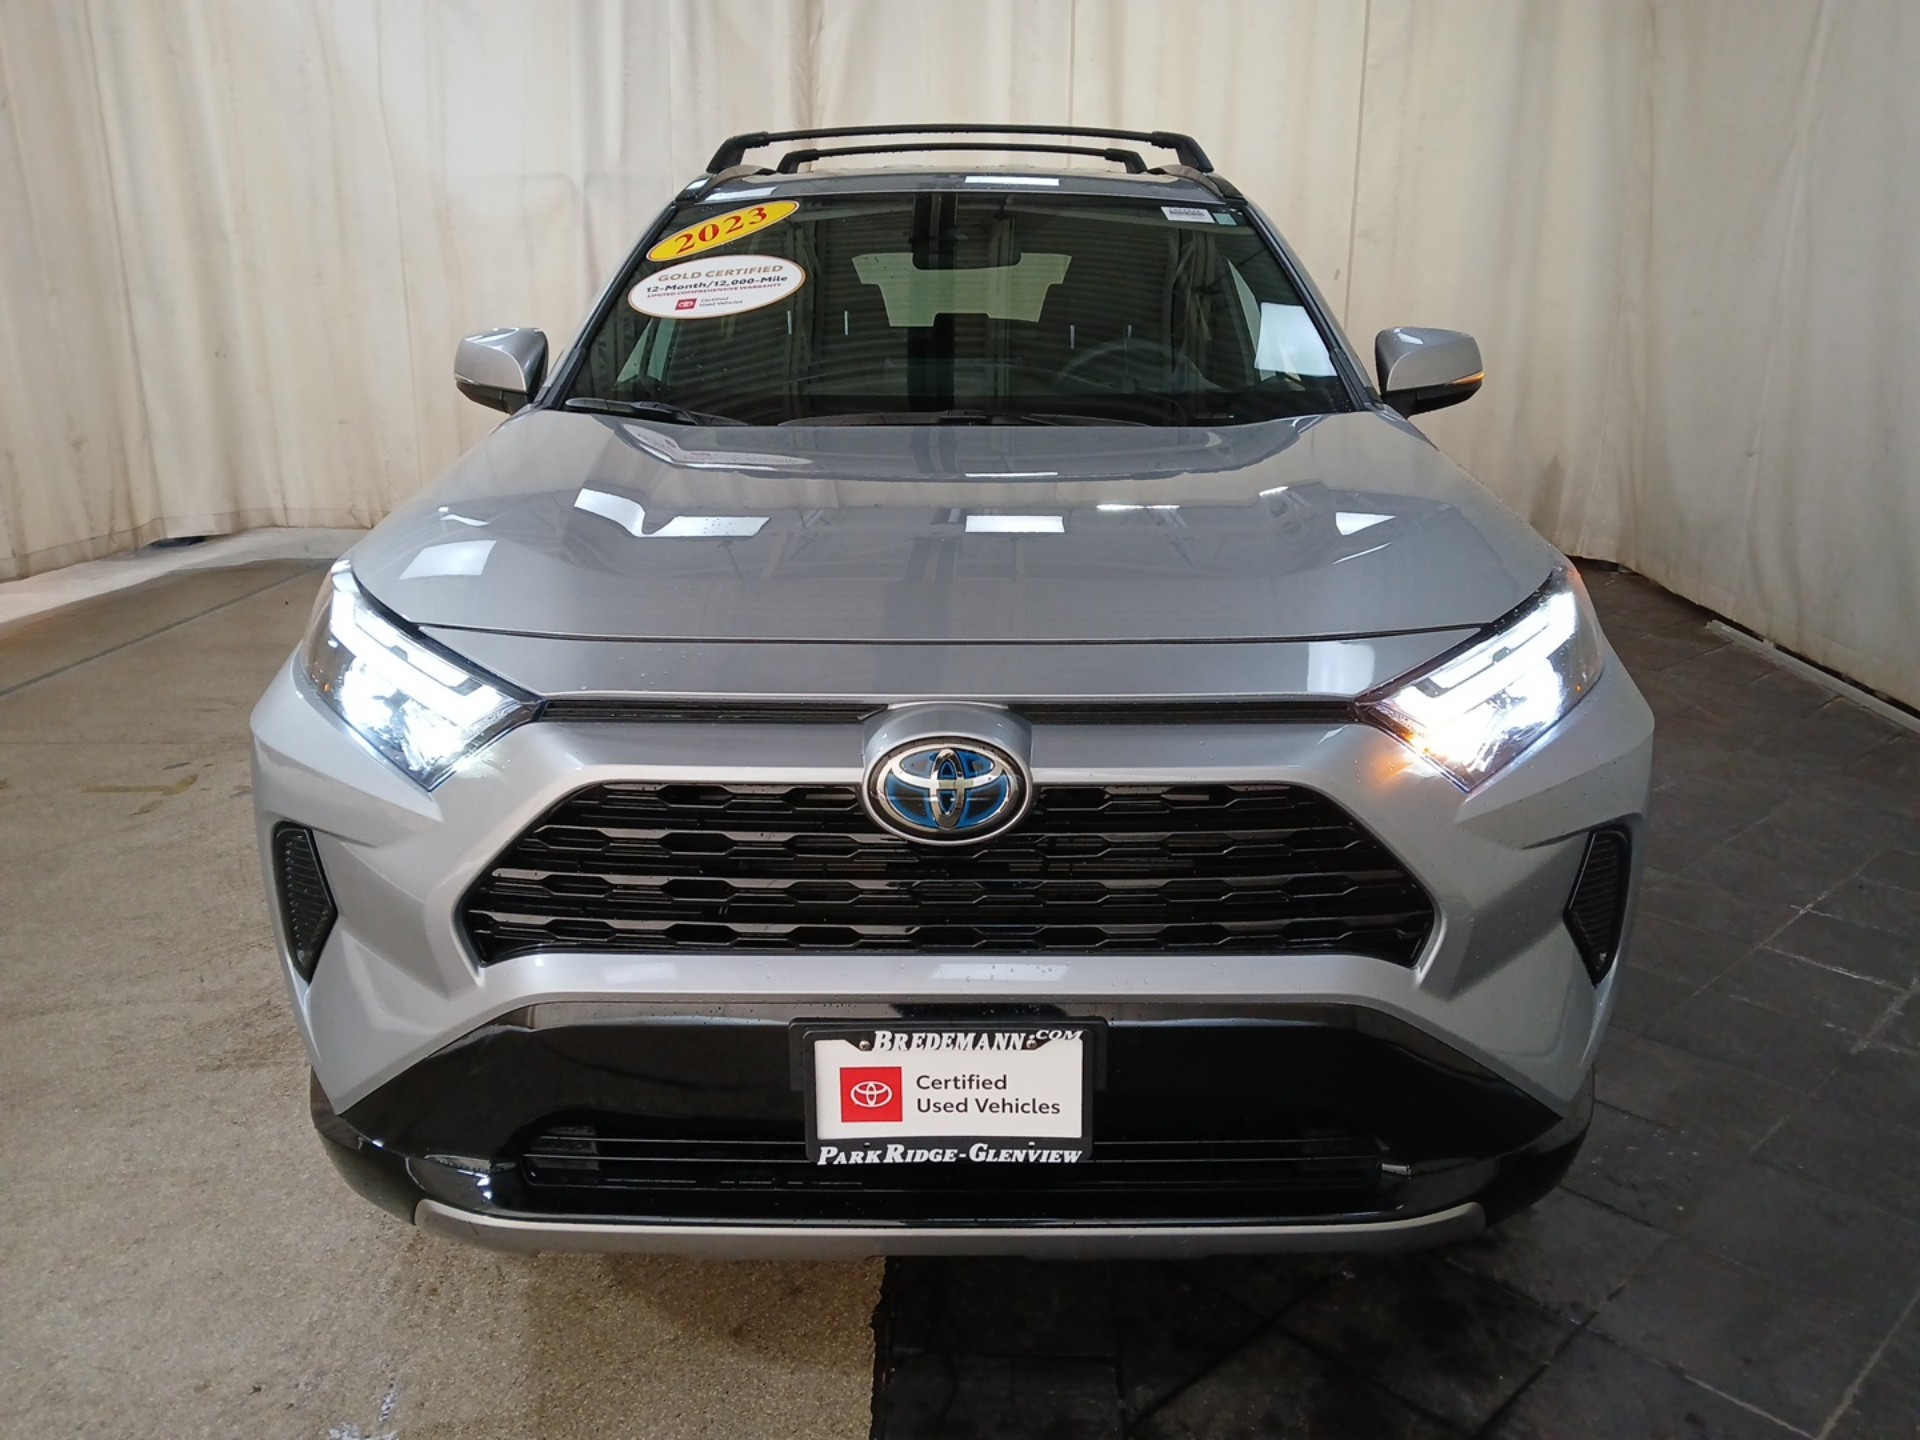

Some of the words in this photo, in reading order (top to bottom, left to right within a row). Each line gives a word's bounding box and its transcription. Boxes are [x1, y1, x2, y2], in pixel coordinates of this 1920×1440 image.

[674, 207, 768, 254] 2023
[658, 271, 702, 282] GOLD
[705, 265, 783, 278] CERTIFIED
[646, 275, 788, 293] 12-Month/12,000-Mile
[677, 286, 738, 295] COMPREHENSIVE
[916, 1074, 1007, 1090] Certified
[917, 1098, 968, 1113] Used
[975, 1098, 1061, 1114] Vehicles
[817, 1146, 883, 1165] PARK
